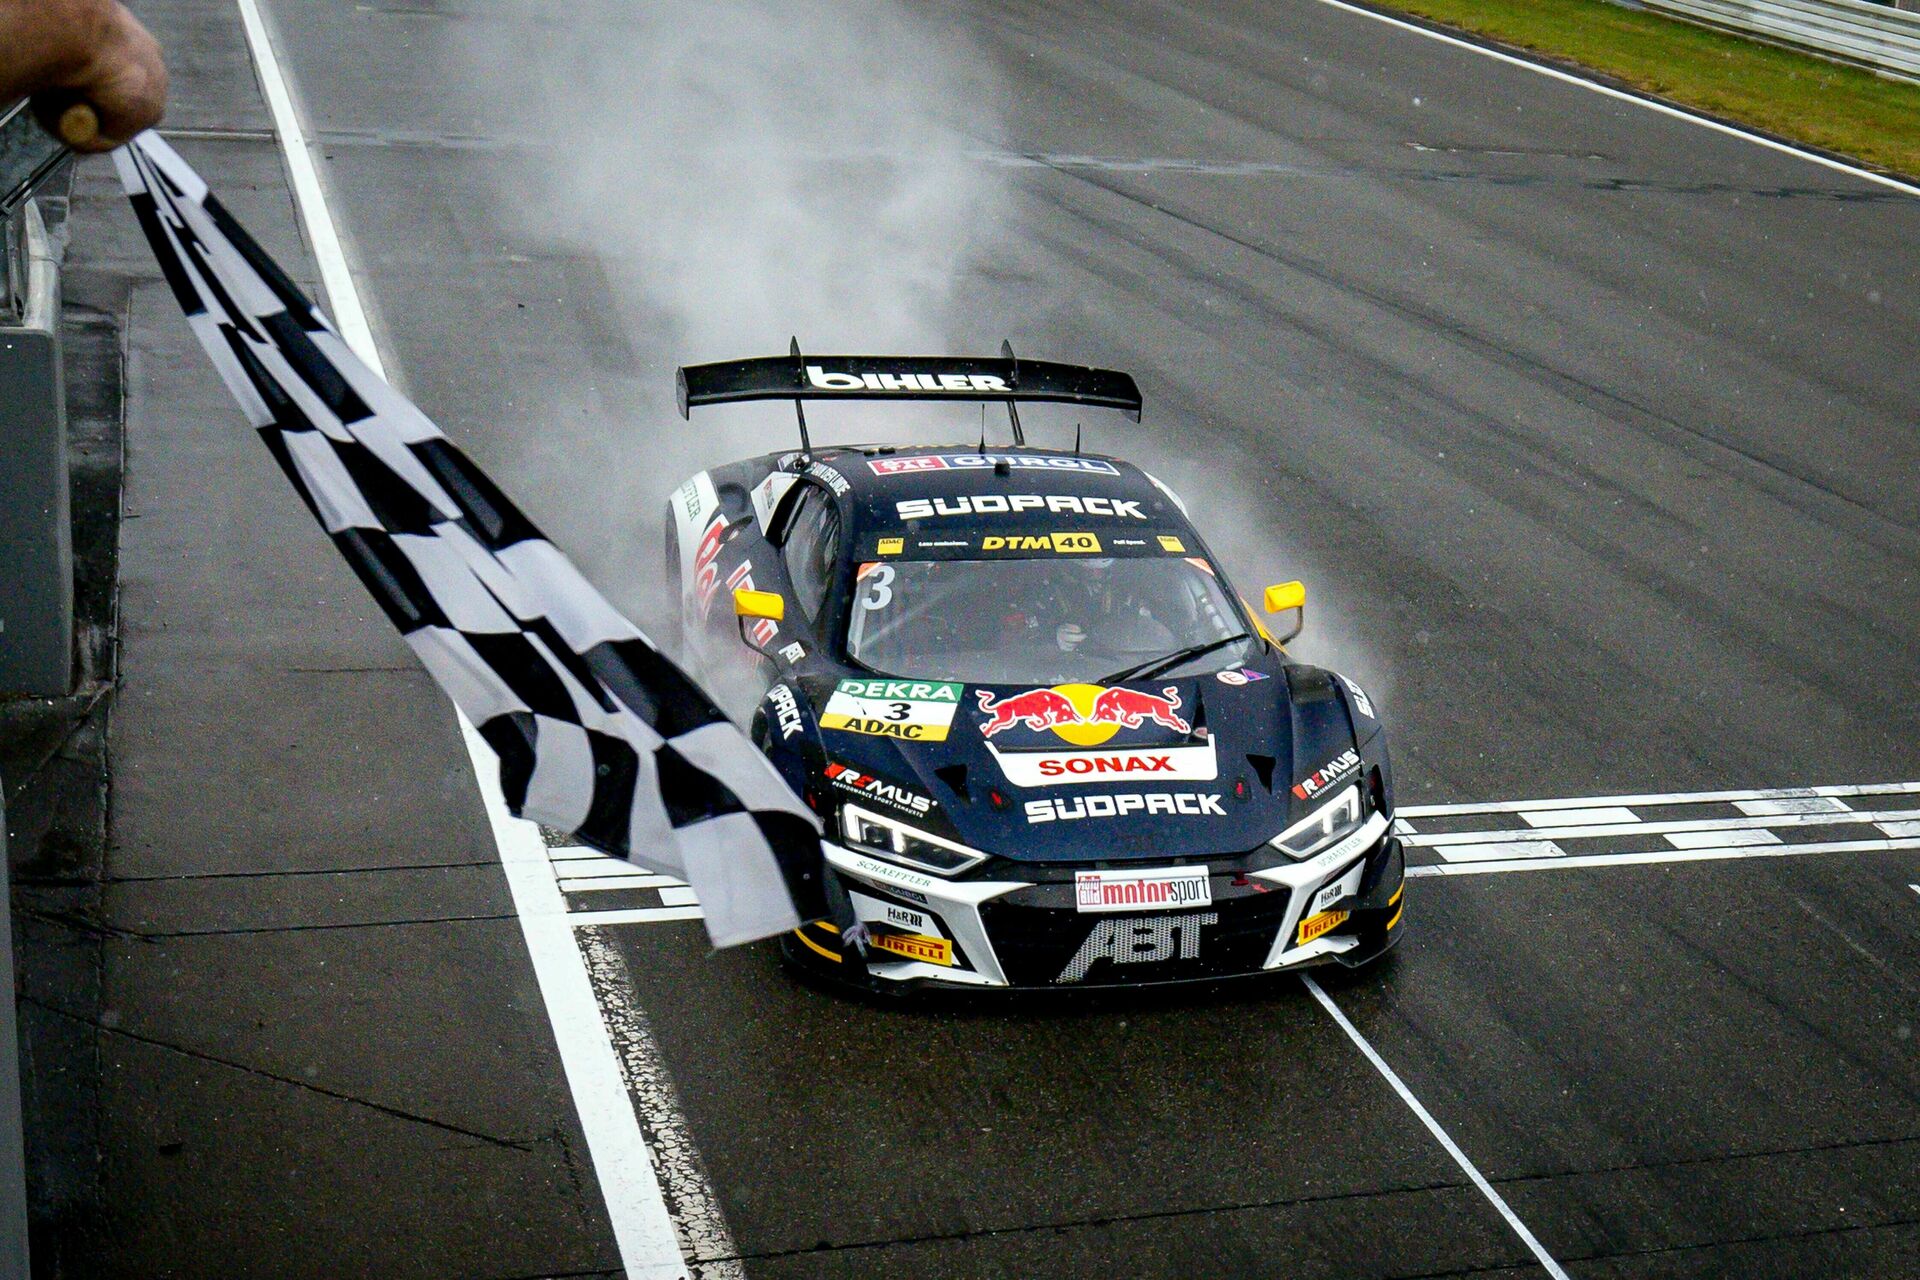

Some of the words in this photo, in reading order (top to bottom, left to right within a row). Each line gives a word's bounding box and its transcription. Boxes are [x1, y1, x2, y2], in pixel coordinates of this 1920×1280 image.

[982, 536, 1052, 550] DTM
[1060, 537, 1092, 548] 40
[862, 565, 896, 610] 3
[840, 681, 956, 701] DEKRA
[884, 702, 912, 721] 3
[843, 717, 923, 739] ADAC
[1038, 756, 1177, 776] SONAX
[1301, 750, 1360, 796] REMUS
[835, 768, 930, 812] REMUS
[1024, 793, 1227, 824] SÜDPACK
[856, 860, 931, 887] SCHAEFFLER
[887, 907, 909, 922] H&R
[877, 935, 944, 960] PIRELLI
[1055, 913, 1218, 984] ABT
